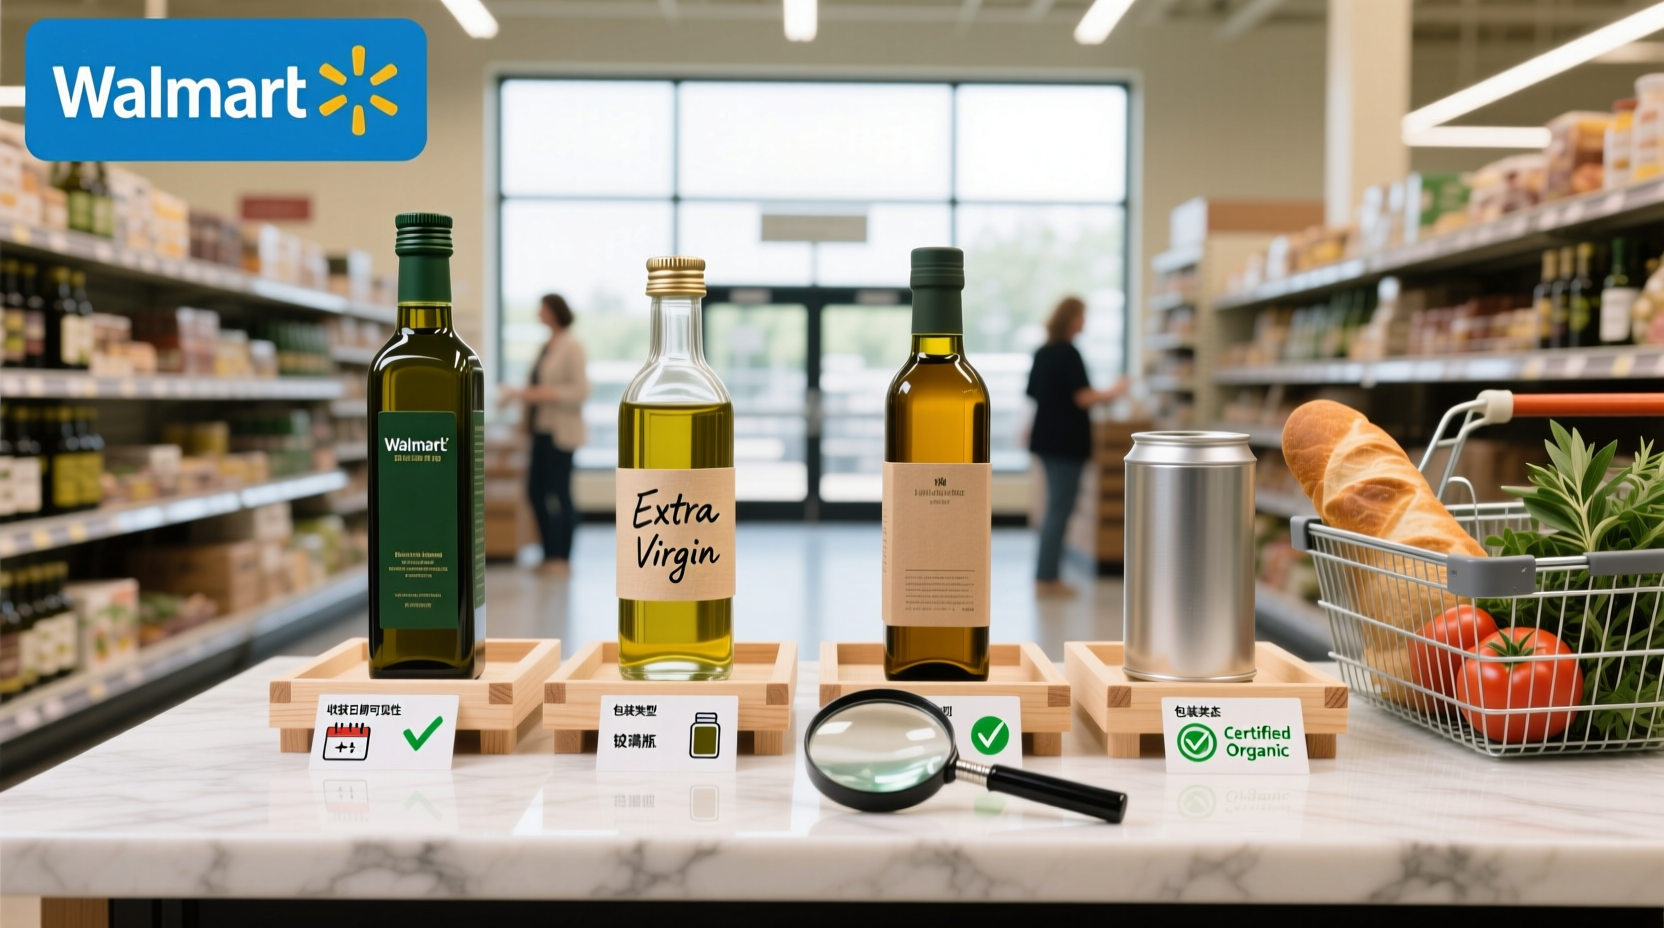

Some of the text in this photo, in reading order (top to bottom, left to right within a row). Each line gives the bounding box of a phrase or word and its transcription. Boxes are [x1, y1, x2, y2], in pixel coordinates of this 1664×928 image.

[384, 437, 449, 452] Walmart
[633, 488, 720, 529] Extra
[637, 533, 721, 584] Virgin
[1224, 725, 1291, 740] Certified
[1226, 743, 1290, 761] Organic
